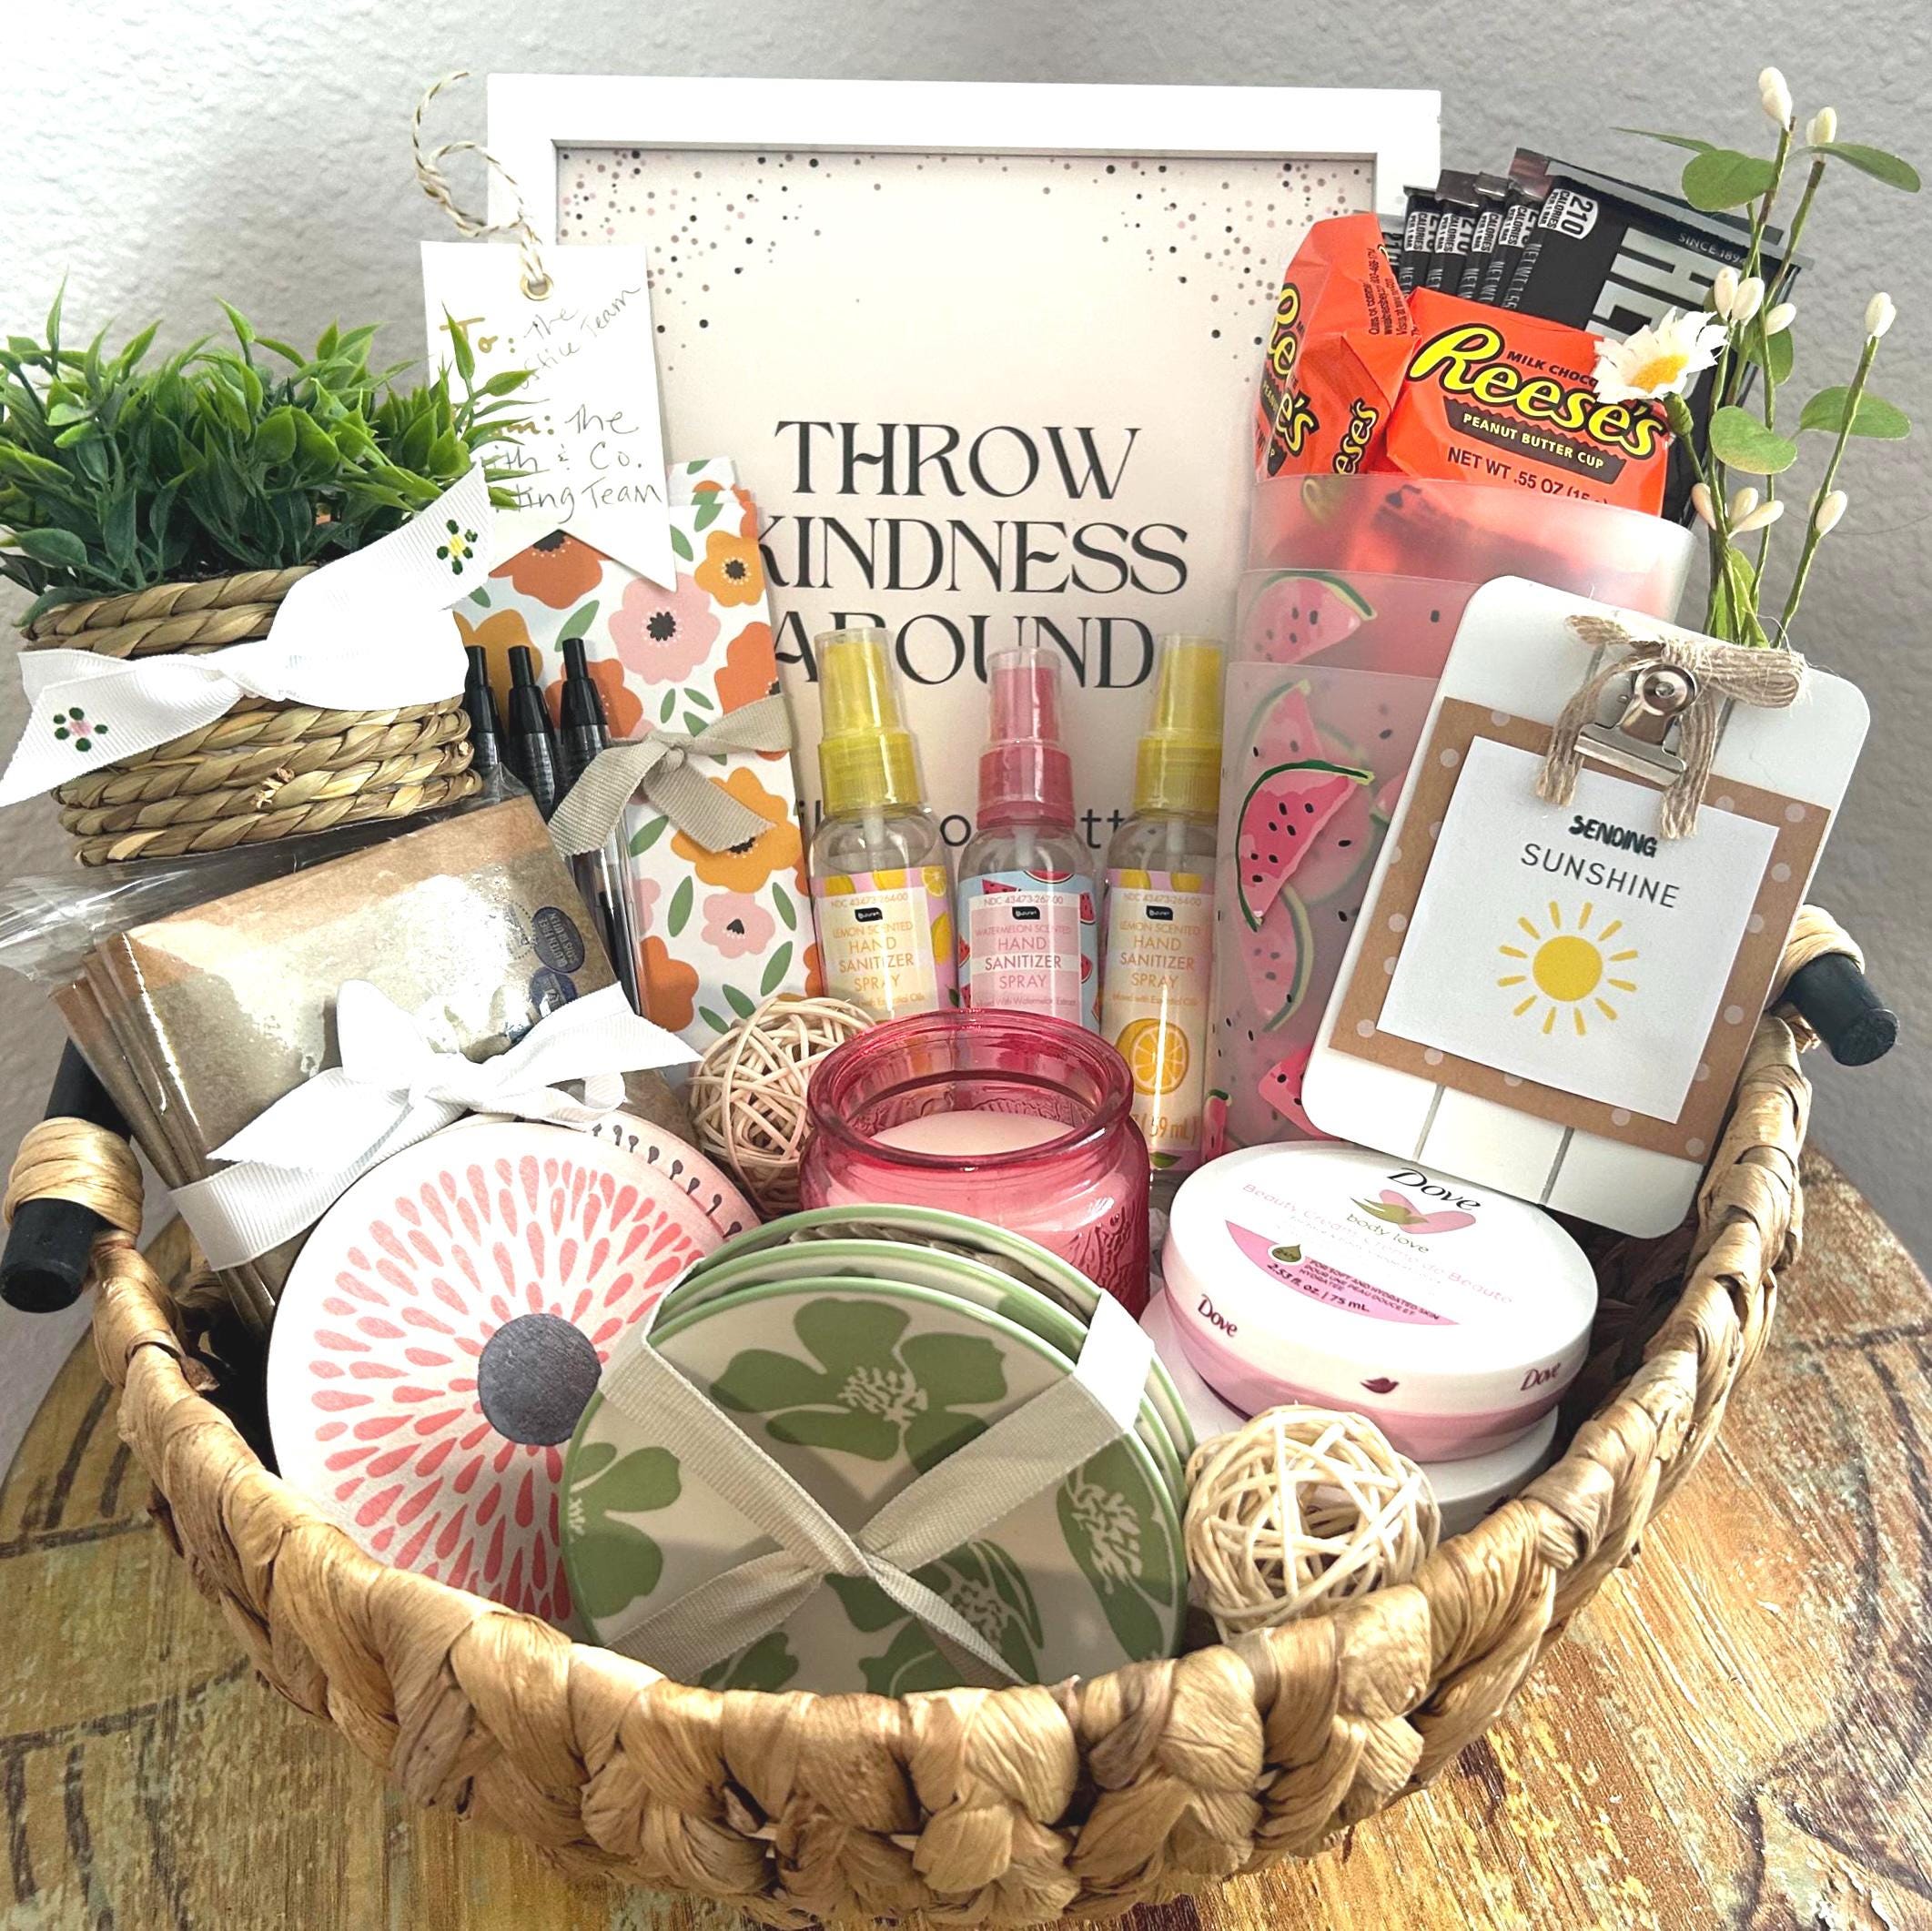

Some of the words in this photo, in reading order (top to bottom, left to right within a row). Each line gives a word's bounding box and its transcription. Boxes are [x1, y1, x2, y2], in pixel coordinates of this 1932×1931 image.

[1548, 190, 1570, 228] CALORIES
[1561, 195, 1593, 236] 210
[1413, 213, 1427, 250] CALORIES
[1481, 214, 1499, 251] CALORIES
[1508, 207, 1527, 245] CALORIES
[1521, 243, 1543, 264] NET
[1677, 232, 1717, 255] SINCE
[1400, 267, 1415, 287] NET
[1426, 268, 1443, 288] NET
[1459, 268, 1480, 288] NET
[1484, 261, 1505, 281] NET
[1512, 266, 1533, 285] WT
[1507, 350, 1546, 370] MILK
[1549, 366, 1598, 387] CHOCO
[1408, 324, 1667, 460] Reese's
[563, 403, 641, 435] The
[590, 440, 643, 470] Co.
[1462, 413, 1519, 441] PEANUT
[1521, 433, 1574, 460] BUTTER
[1577, 450, 1605, 470] CUP
[774, 420, 1142, 500] THROW
[1447, 446, 1482, 470] NET
[1485, 457, 1512, 480] WT
[1513, 469, 1538, 491] .55
[1542, 479, 1564, 495] OZ
[581, 475, 663, 510] Team
[774, 611, 1154, 689] AOUND
[1568, 814, 1658, 858] SENDING
[1521, 843, 1681, 908] SUNSHINE
[833, 926, 865, 938] LEMON
[866, 921, 914, 935] SCNTED
[976, 925, 1033, 936] WATERMELON
[997, 936, 1047, 951] HAND
[1119, 919, 1152, 931] LEMON
[1155, 923, 1201, 935] SCENTED
[1134, 935, 1182, 951] HAND
[985, 955, 1062, 971] SANITIZER
[1120, 952, 1195, 971] SANITIZER
[999, 975, 1047, 989] SPRAY
[1131, 972, 1179, 988] SPRAY
[1242, 1183, 1298, 1212] Beauty
[1387, 1167, 1482, 1211] Dove
[1346, 1213, 1391, 1236] body
[1392, 1232, 1430, 1254] love
[1267, 1263, 1293, 1281] 2.53
[1330, 1294, 1346, 1306] 75
[1309, 1259, 1327, 1270] FOR
[1328, 1265, 1350, 1279] SOFT
[1351, 1278, 1371, 1289] AND
[1371, 1286, 1418, 1310] HYDRATED
[1418, 1308, 1440, 1319] SKIN
[1329, 1274, 1347, 1286] UNE
[1348, 1282, 1371, 1297] PEAU
[1371, 1294, 1401, 1310] DOUCE
[1401, 1308, 1416, 1316] ET
[1198, 1294, 1239, 1338] Dove
[1519, 1361, 1563, 1391] Dove
